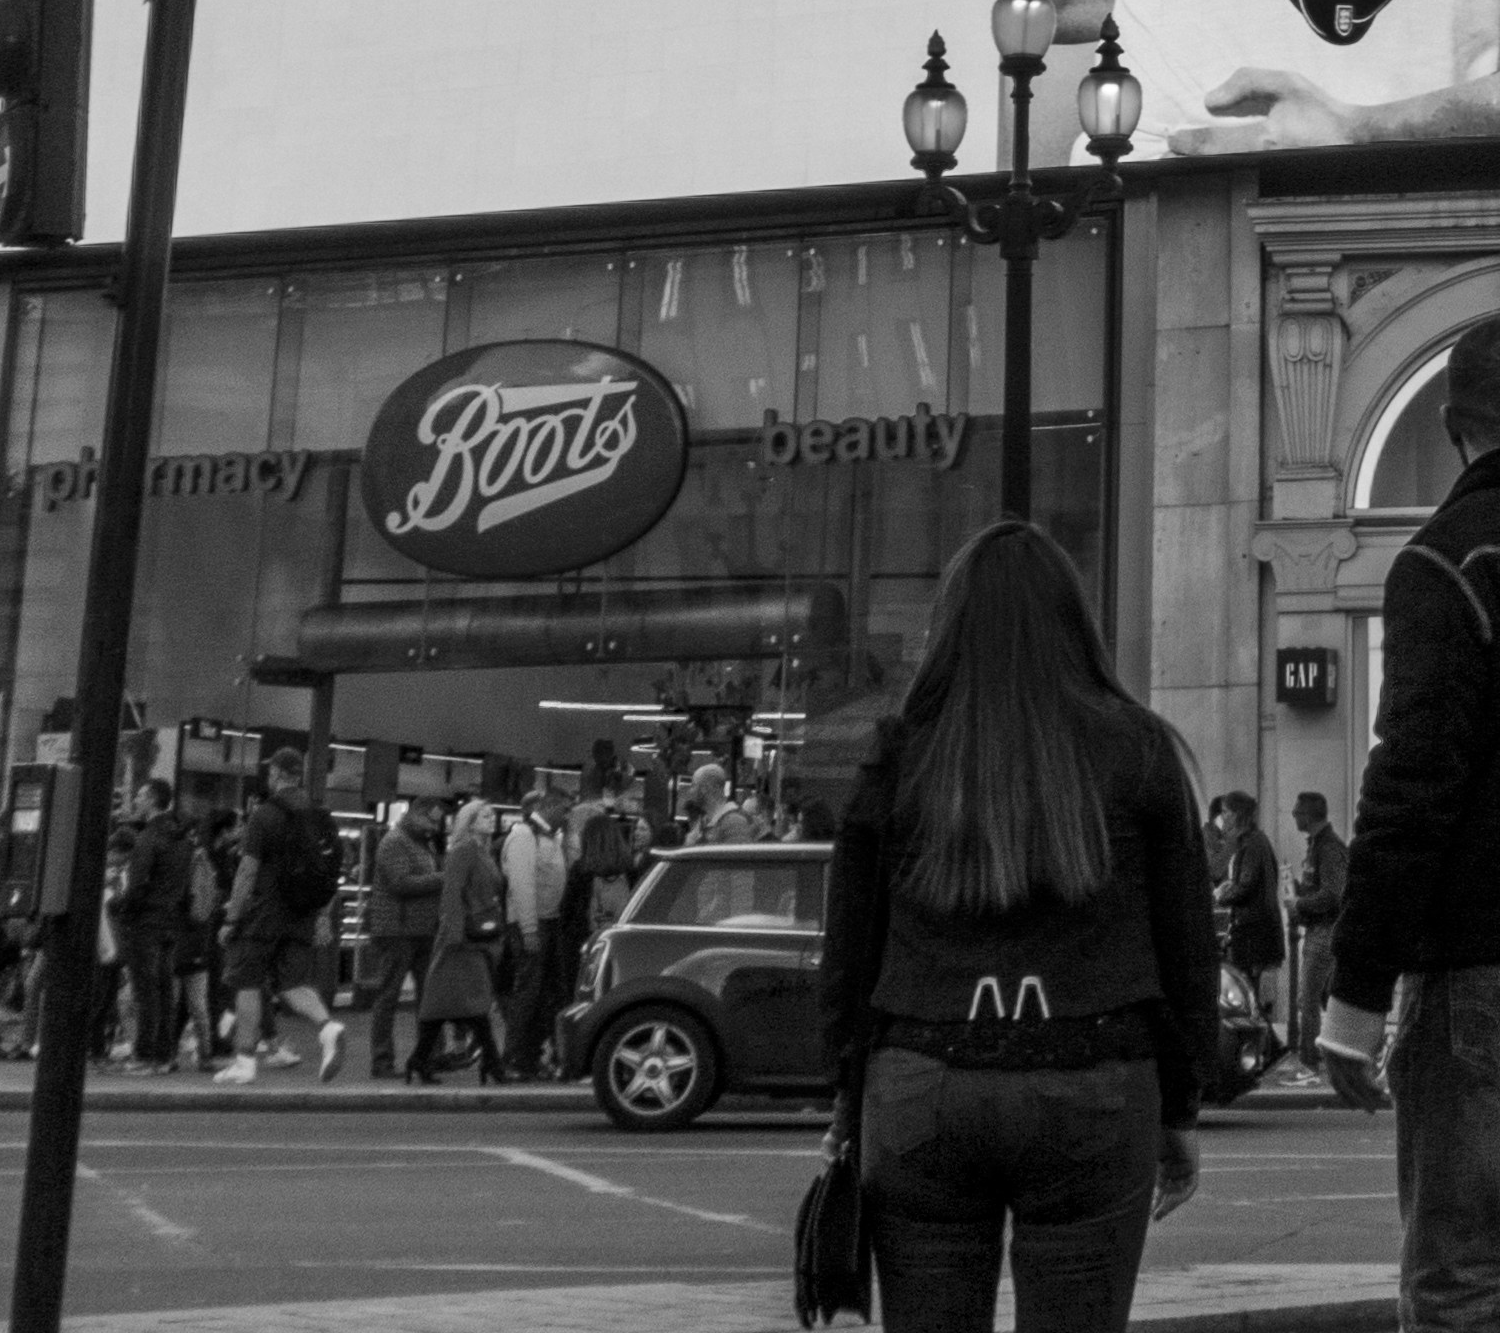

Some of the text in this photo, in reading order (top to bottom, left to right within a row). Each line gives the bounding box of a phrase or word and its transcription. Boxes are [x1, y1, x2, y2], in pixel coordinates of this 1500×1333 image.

[386, 375, 639, 535] Boots
[762, 400, 970, 469] beauty
[36, 444, 306, 514] phrmacy
[1285, 661, 1319, 690] GAP
